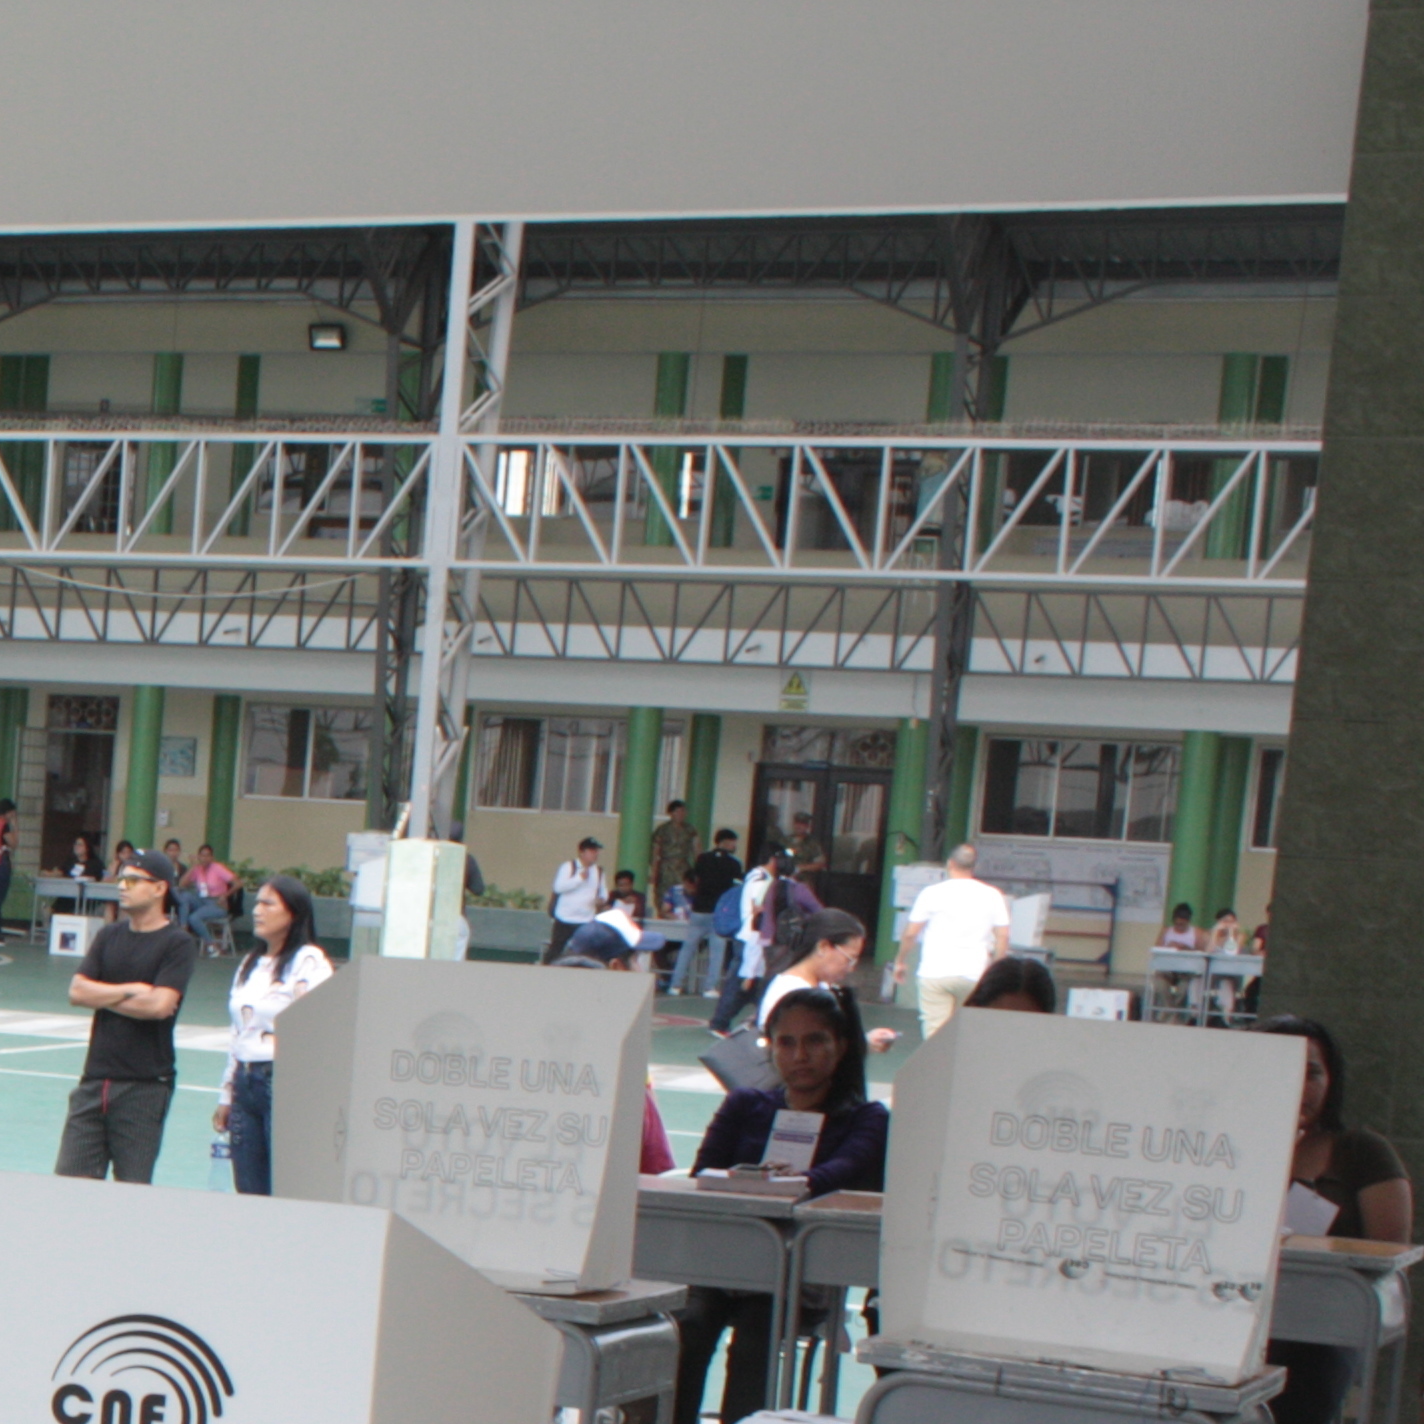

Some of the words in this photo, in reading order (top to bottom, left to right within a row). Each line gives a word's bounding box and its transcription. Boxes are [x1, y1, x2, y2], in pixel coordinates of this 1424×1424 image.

[390, 1049, 512, 1090] DOBLE
[520, 1058, 600, 1097] UNA
[372, 1096, 471, 1137] SOLA
[478, 1105, 550, 1144] VEZ
[555, 1112, 608, 1148] SU
[990, 1111, 1132, 1159] DOBLE
[1141, 1126, 1237, 1170] UNA
[400, 1148, 584, 1196] PAPELETA
[968, 1162, 1081, 1207] SOLA
[1090, 1174, 1174, 1216] VEZ
[1181, 1184, 1245, 1224] SU
[995, 1217, 1213, 1276] PAPELETA
